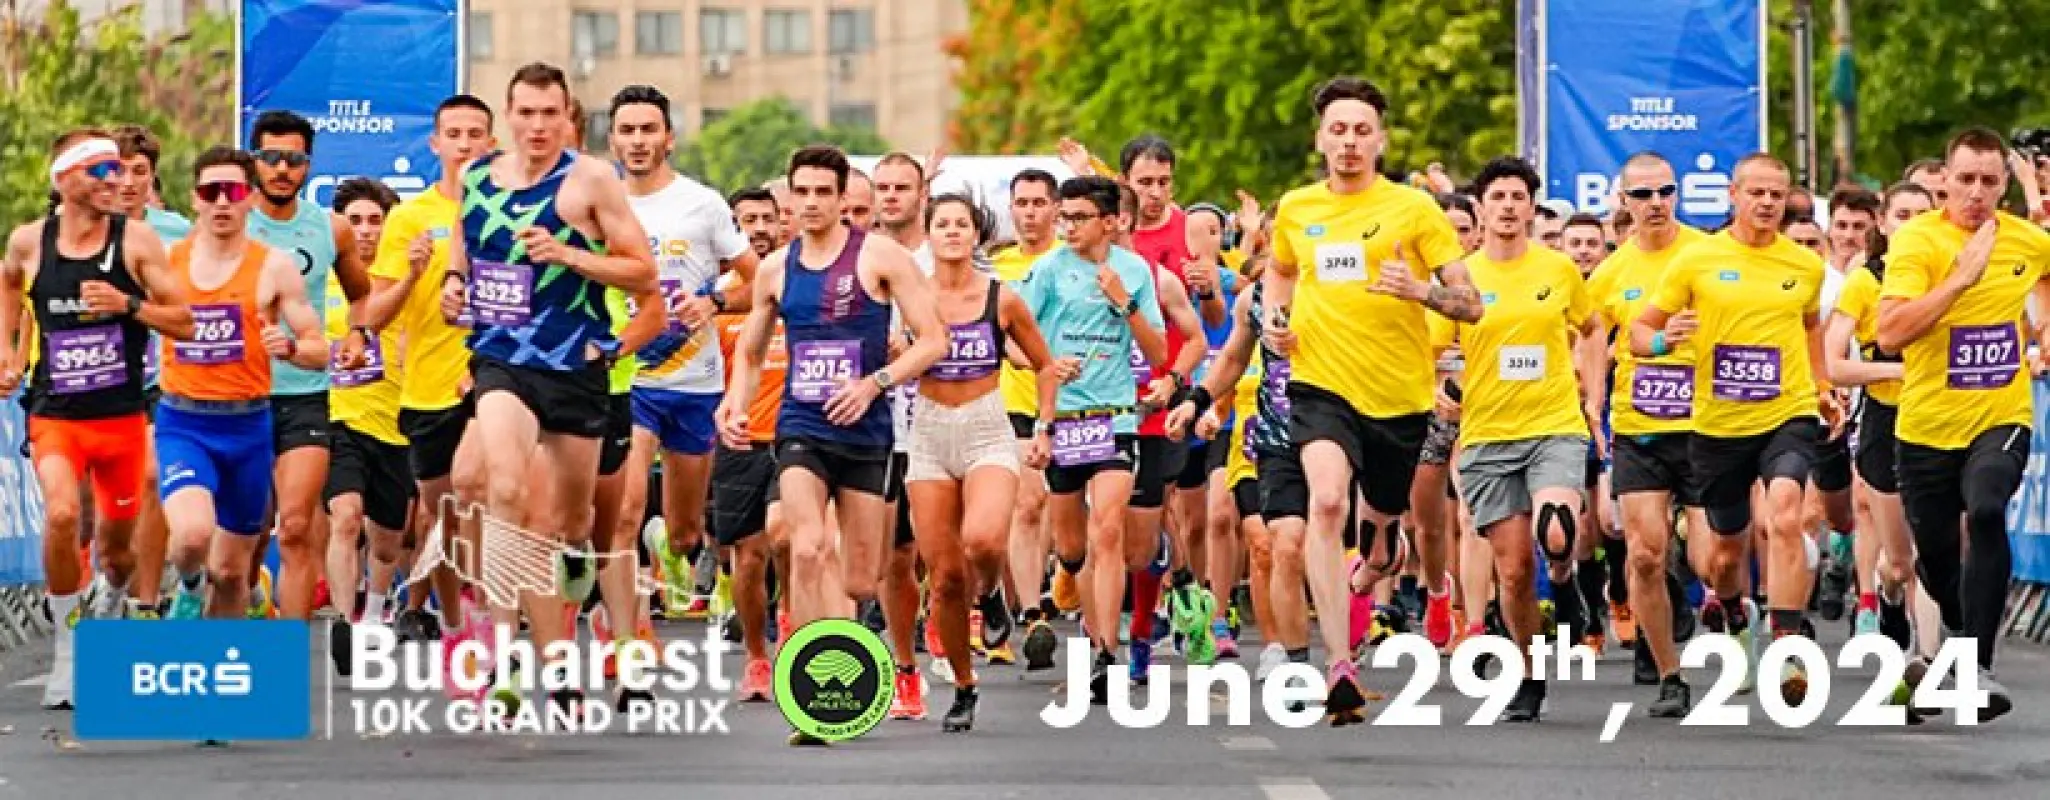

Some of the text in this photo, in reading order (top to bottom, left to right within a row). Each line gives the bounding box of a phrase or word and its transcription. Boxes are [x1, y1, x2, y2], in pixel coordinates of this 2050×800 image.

[329, 99, 371, 116] TITLE
[1630, 97, 1676, 113] TITLE
[1607, 114, 1699, 131] SPONSOR
[194, 319, 236, 341] 769
[56, 342, 120, 370] 3966
[951, 339, 988, 359] 148
[1954, 340, 2014, 367] 3107
[799, 359, 853, 379] 3015
[1719, 359, 1776, 381] 3558
[1638, 379, 1692, 399] 3726
[1056, 424, 1109, 447] 3899
